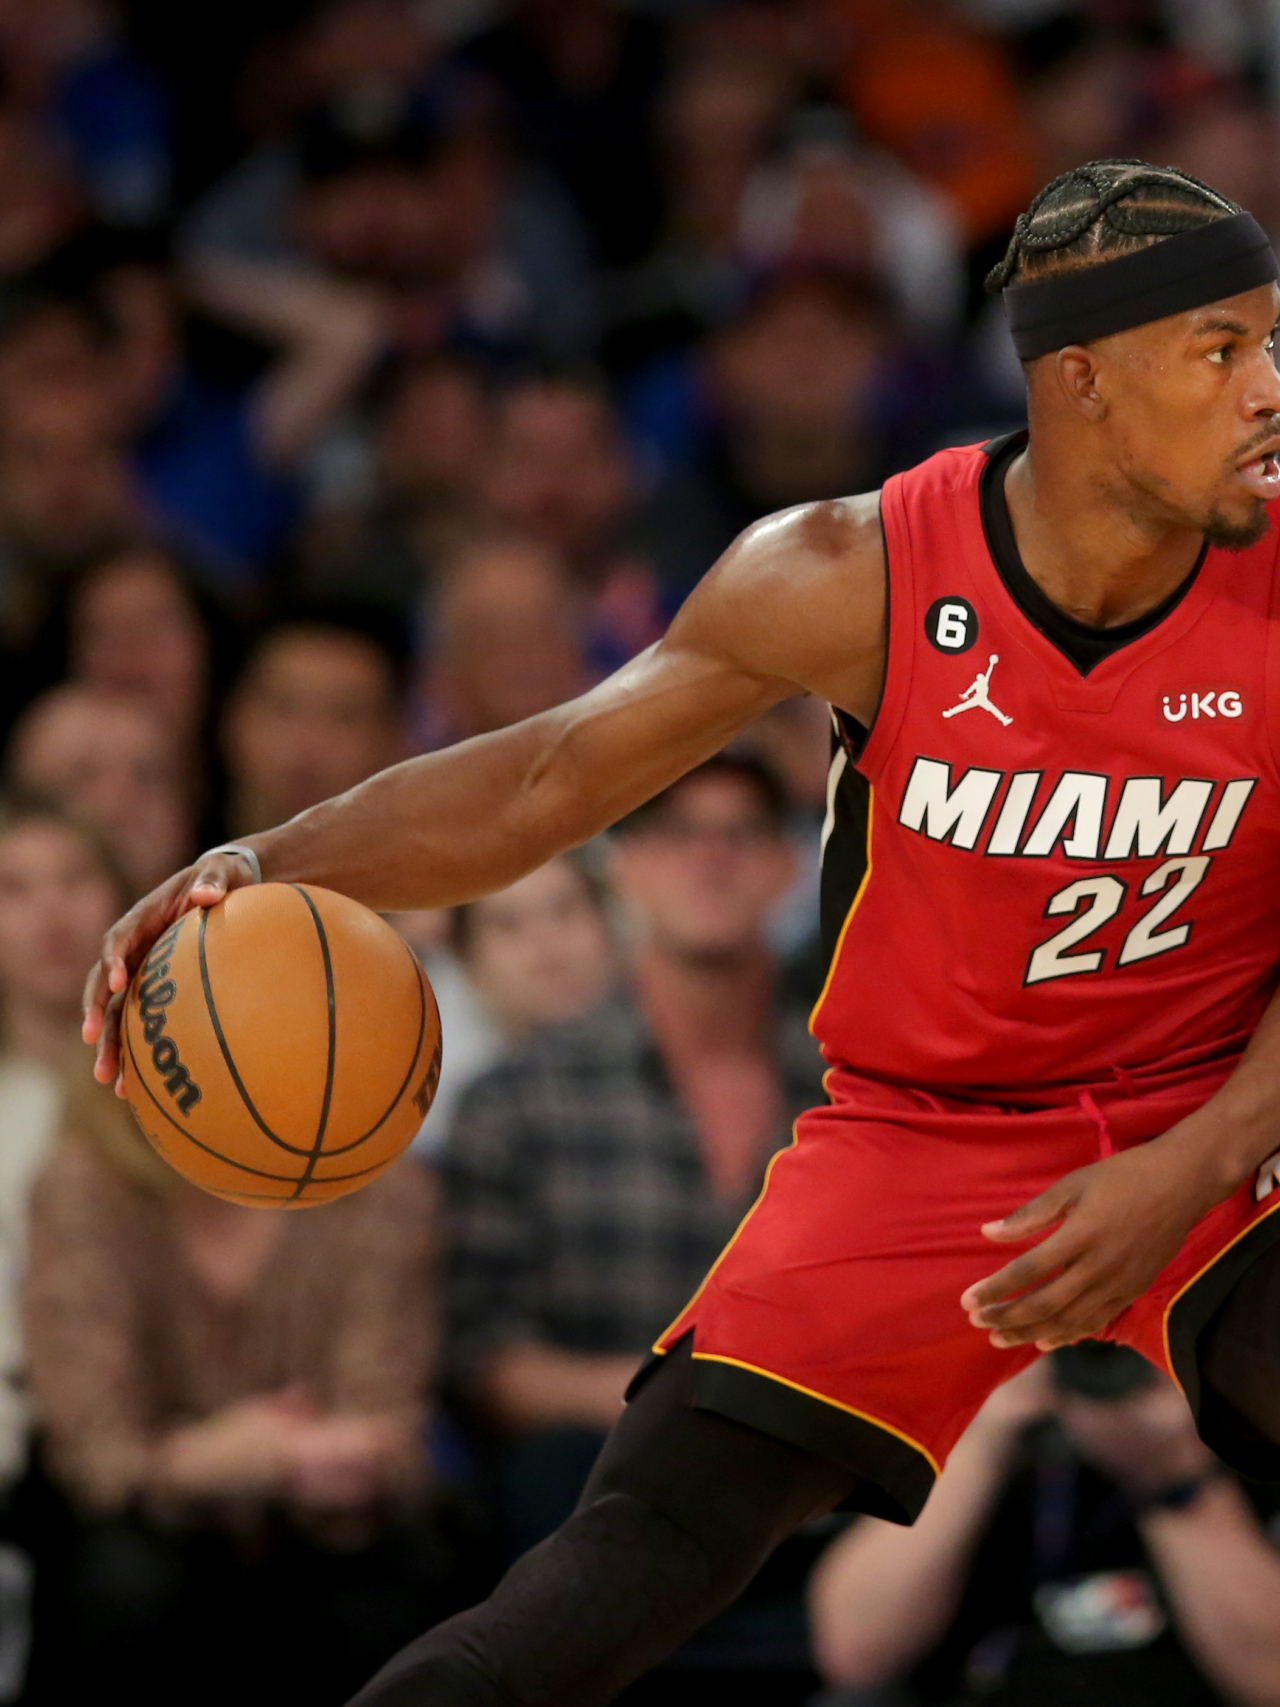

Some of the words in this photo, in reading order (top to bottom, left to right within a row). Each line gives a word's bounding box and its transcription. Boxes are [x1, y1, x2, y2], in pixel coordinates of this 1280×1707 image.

[935, 603, 968, 649] 6
[899, 754, 1260, 861] MIAMI
[1021, 855, 1215, 988] 22
[139, 916, 203, 1118] Wilson
